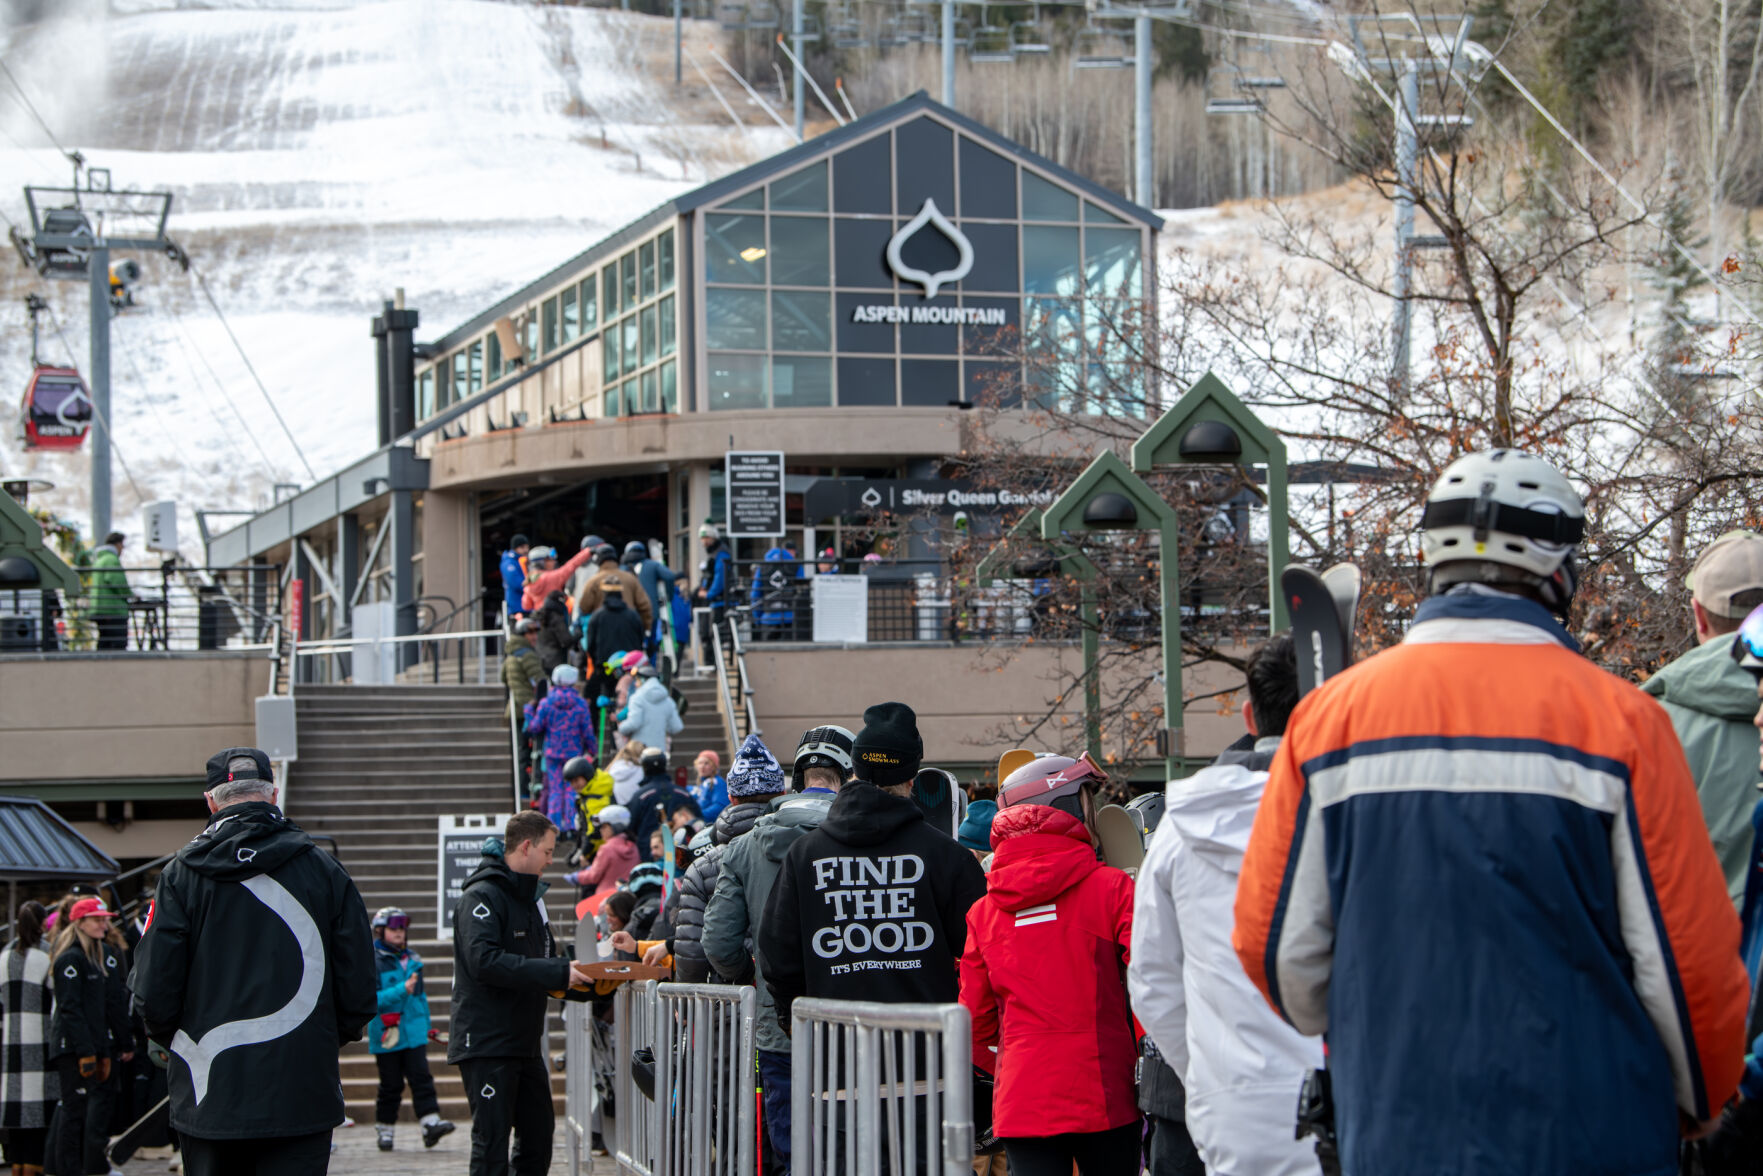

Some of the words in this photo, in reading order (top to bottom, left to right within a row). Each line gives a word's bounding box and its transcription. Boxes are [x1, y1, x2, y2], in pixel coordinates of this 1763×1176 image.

[853, 305, 910, 323] ASPEN
[911, 306, 1006, 325] MOUNTAIN
[902, 489, 946, 506] Silver
[947, 489, 997, 507] Queen
[812, 854, 925, 891] FIND
[824, 887, 915, 921] THE
[811, 921, 935, 959] GOOD
[830, 964, 851, 975] IT'S
[852, 959, 922, 972] EVERYWHERE
